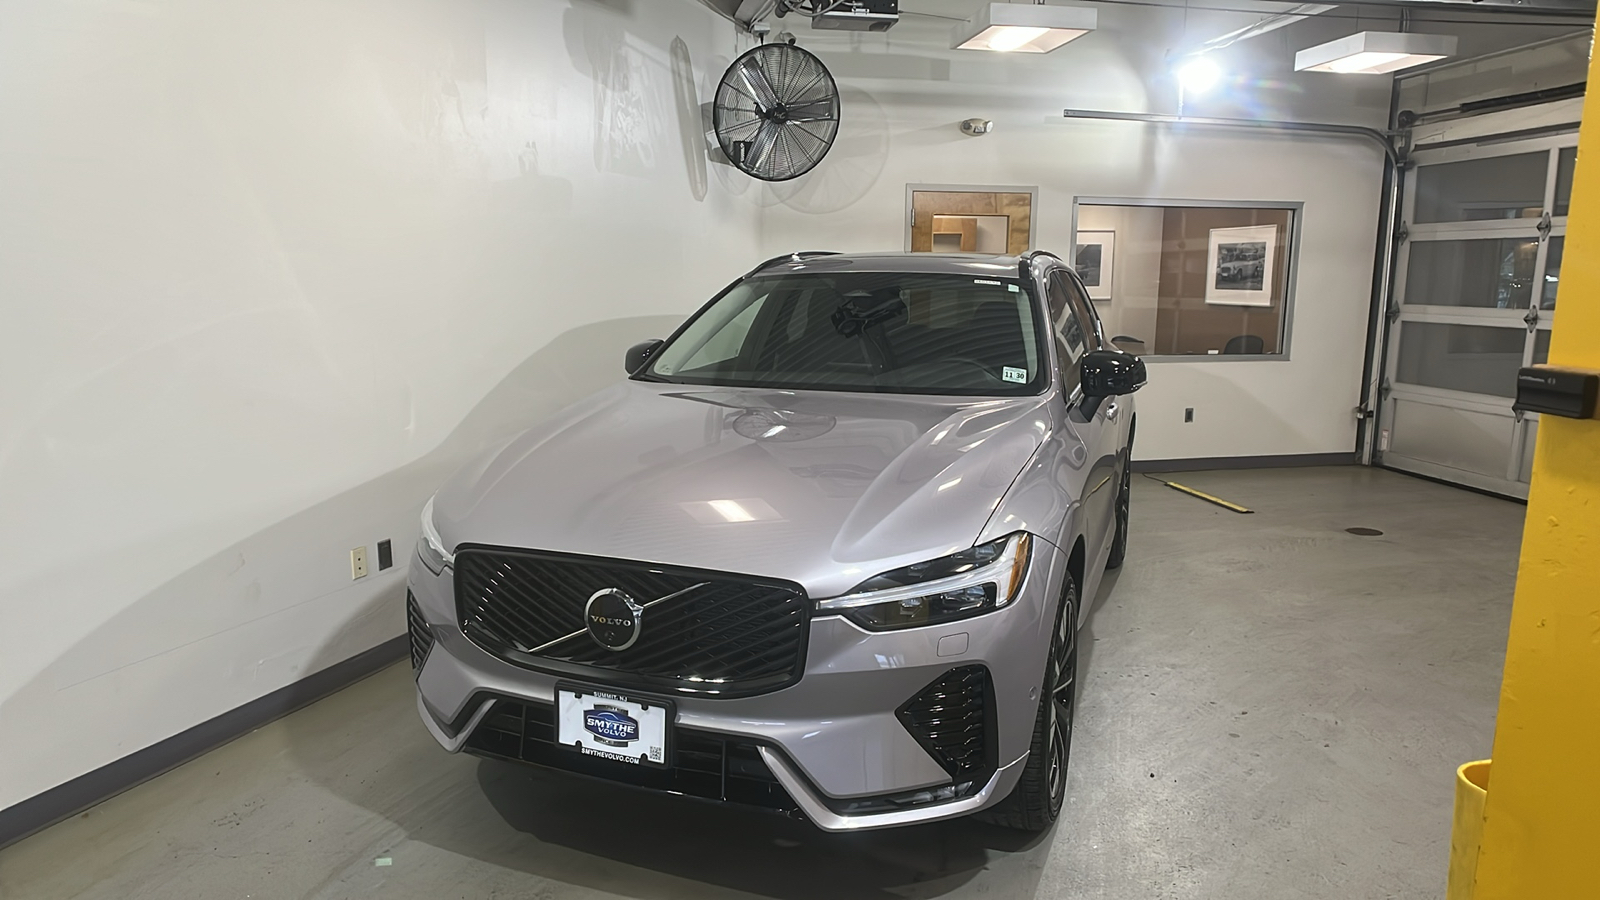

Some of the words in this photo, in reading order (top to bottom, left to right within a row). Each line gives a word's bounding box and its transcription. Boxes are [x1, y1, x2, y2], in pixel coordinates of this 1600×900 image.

[591, 615, 631, 626] VOLVO
[587, 718, 635, 733] SMYTHE
[598, 727, 627, 737] VOLVO
[581, 747, 640, 764] SMYTHEVOLVO.COM
